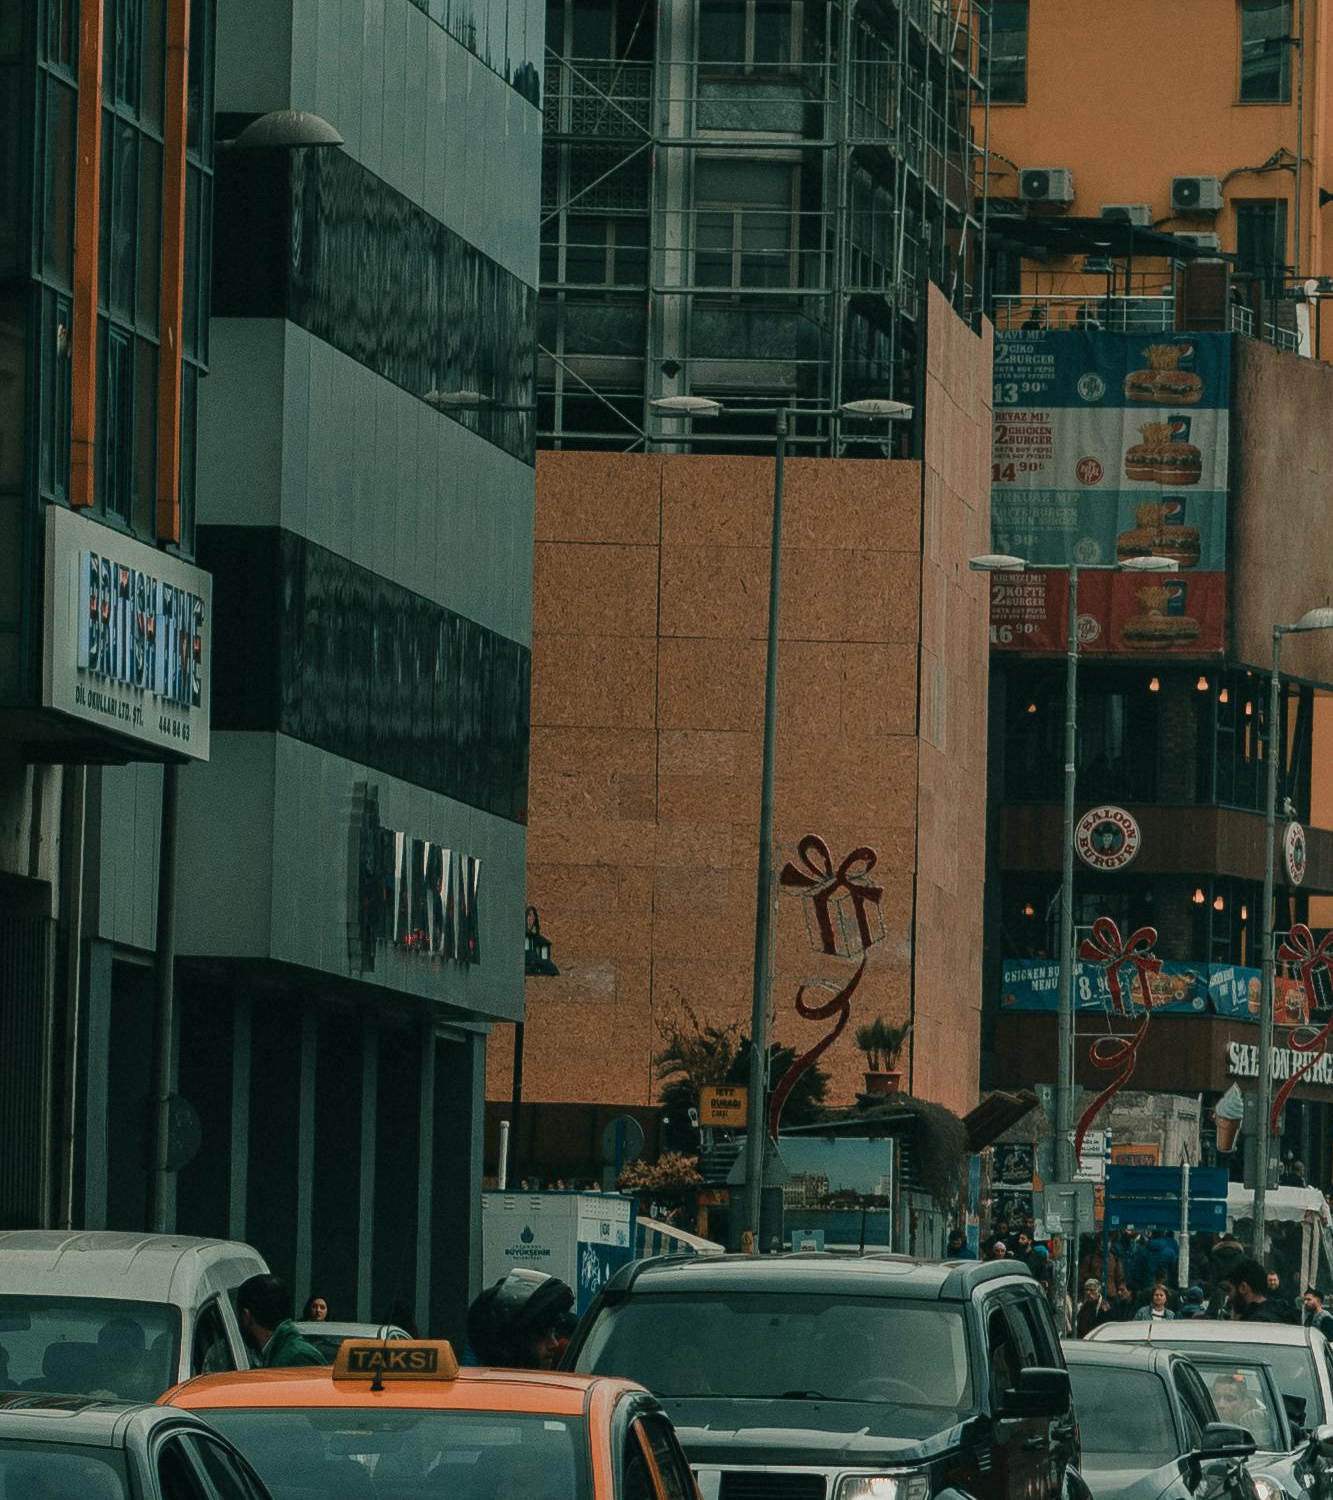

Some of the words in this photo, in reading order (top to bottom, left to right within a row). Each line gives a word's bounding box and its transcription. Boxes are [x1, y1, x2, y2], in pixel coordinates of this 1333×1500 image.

[995, 343, 1009, 364] 2
[1008, 354, 1055, 365] BURGER
[995, 425, 1008, 445] 2
[1008, 427, 1052, 435] CHICKEN
[1008, 436, 1052, 445] BURGER
[992, 585, 1005, 605] 2
[1006, 598, 1045, 606] BURGER
[88, 551, 157, 692] BRITISH
[160, 581, 203, 709] TIME
[88, 690, 117, 718] OKULLARI
[159, 715, 171, 735] 444
[1082, 809, 1136, 840] SALOON
[1079, 835, 1135, 867] BURGER
[1004, 968, 1046, 983] CHICKEN
[1228, 1041, 1290, 1080] SALON
